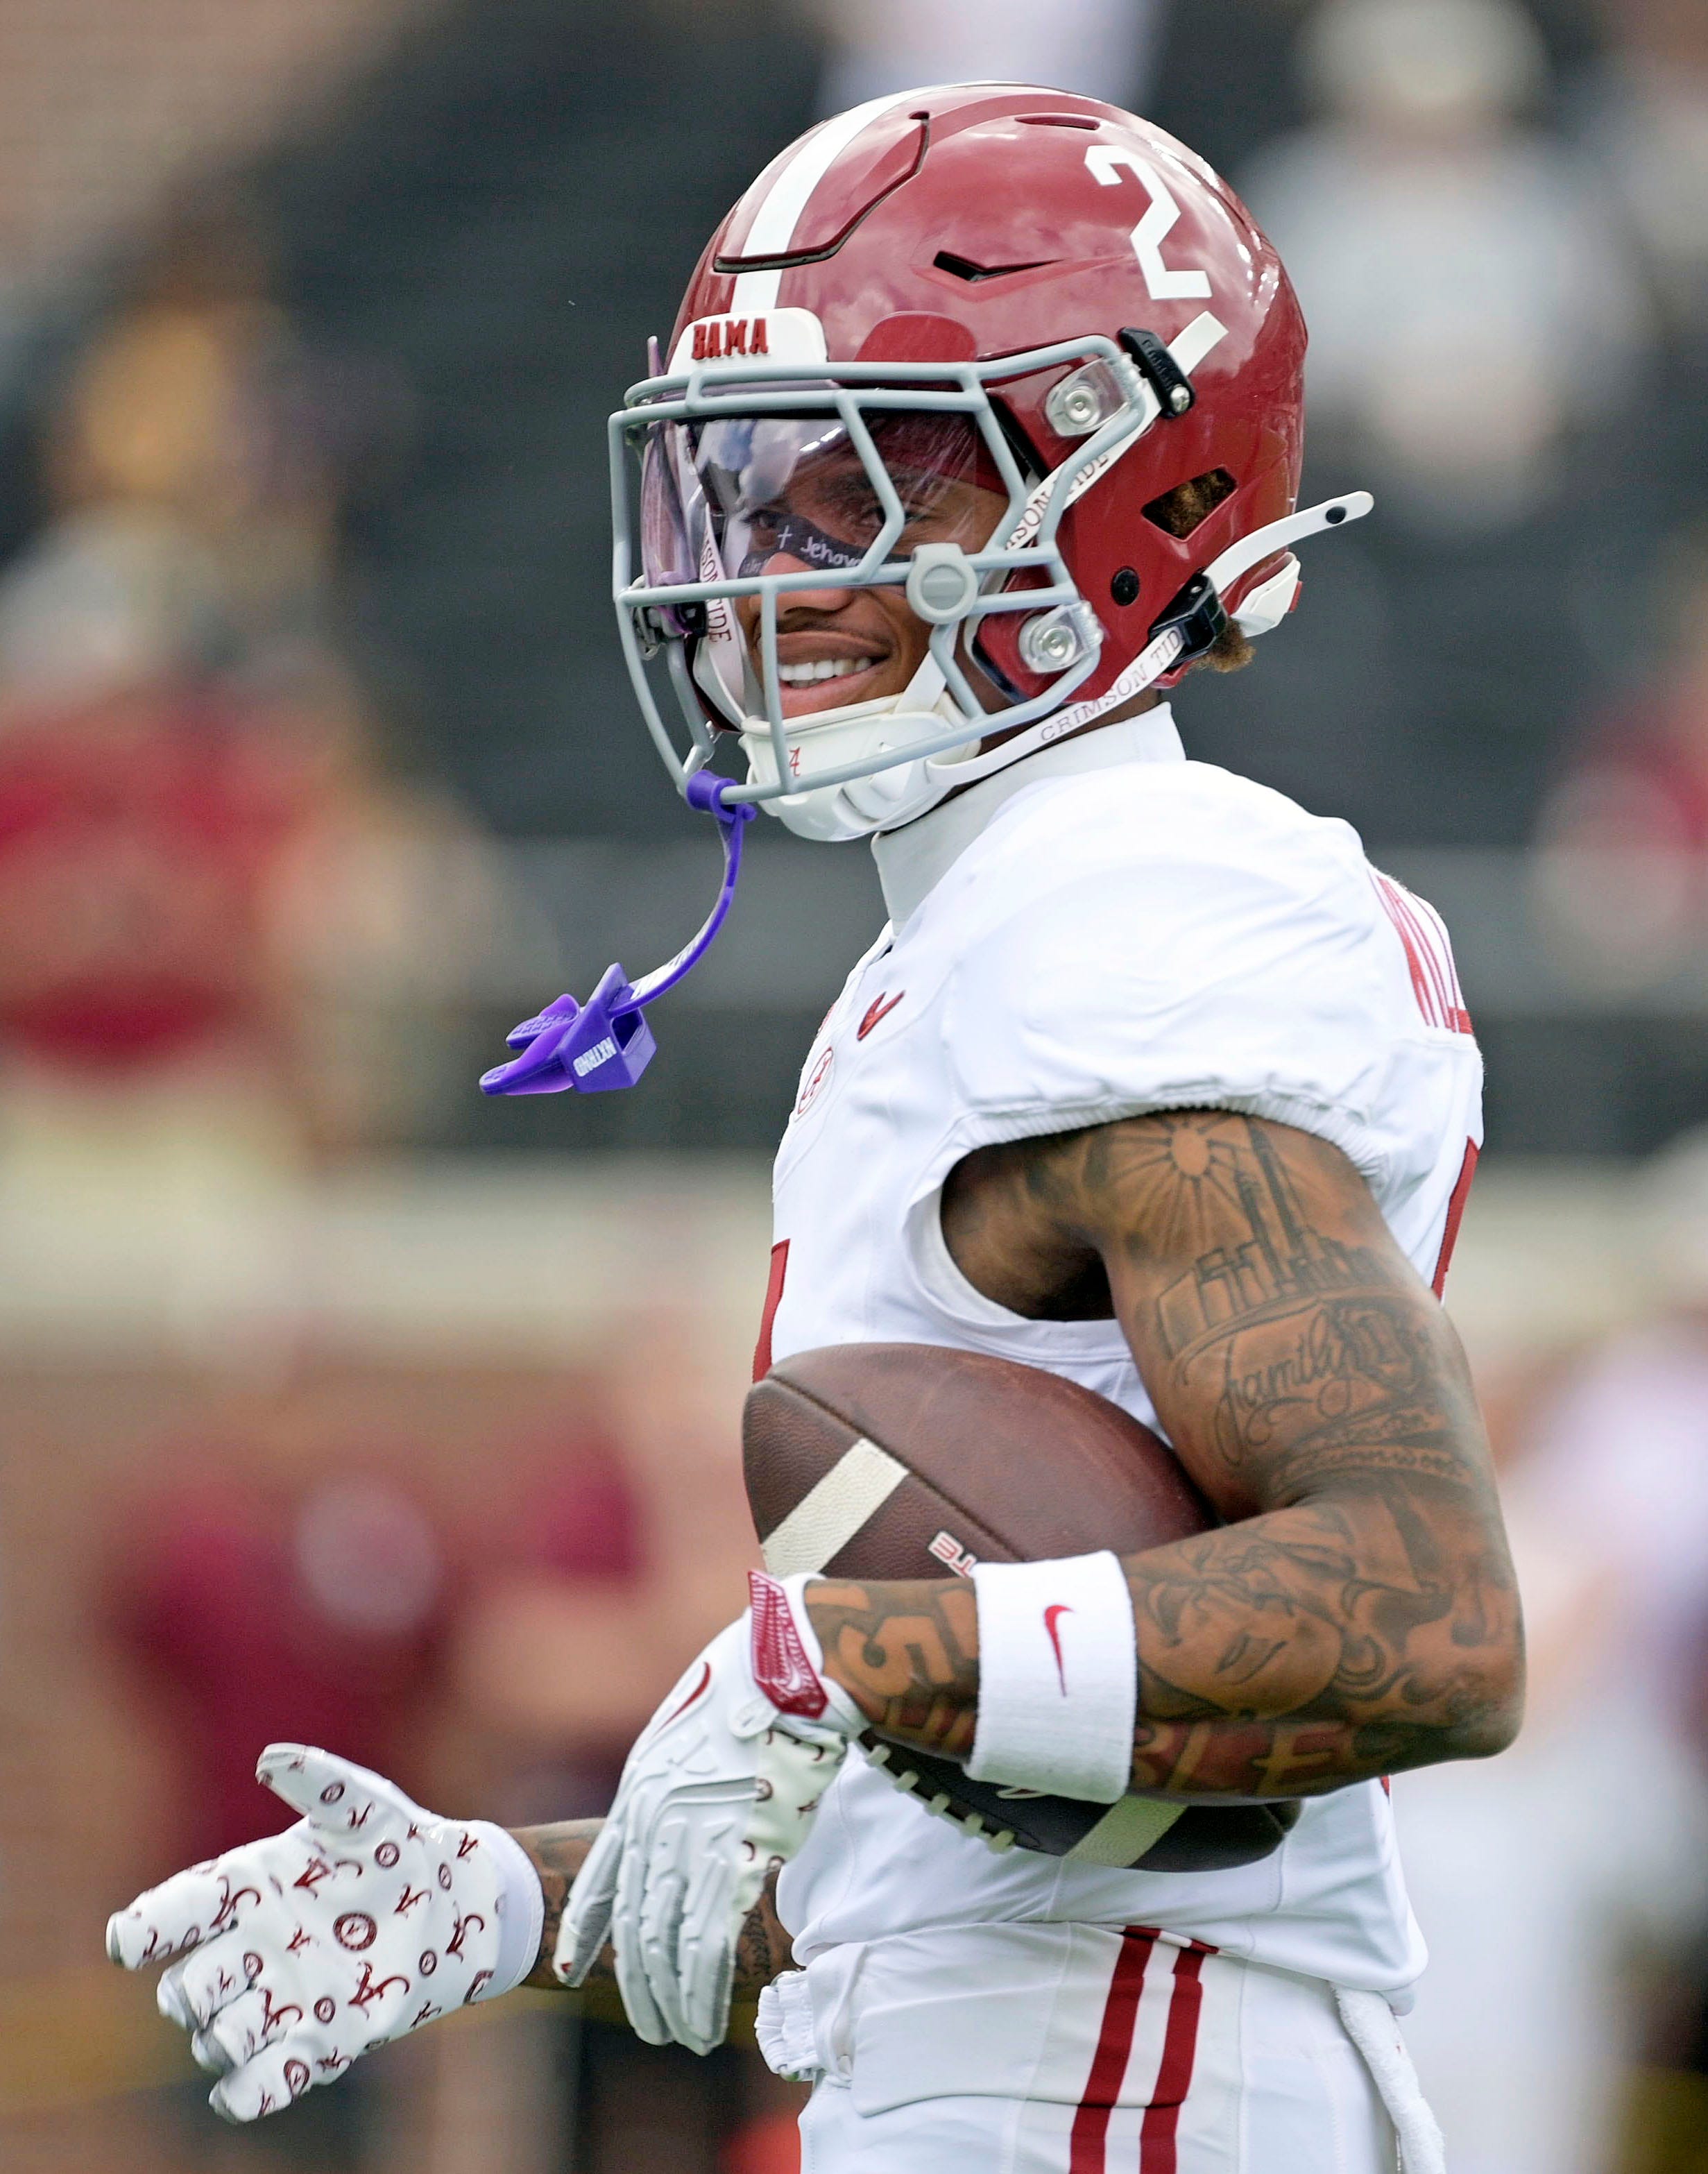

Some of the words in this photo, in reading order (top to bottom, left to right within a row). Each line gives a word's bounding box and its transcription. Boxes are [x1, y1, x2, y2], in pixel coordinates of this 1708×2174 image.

[1084, 144, 1213, 293] 2
[692, 318, 768, 360] BAMA
[1041, 663, 1148, 741] CRIMSON
[1150, 629, 1181, 668] TID
[928, 1531, 975, 1577] TE
